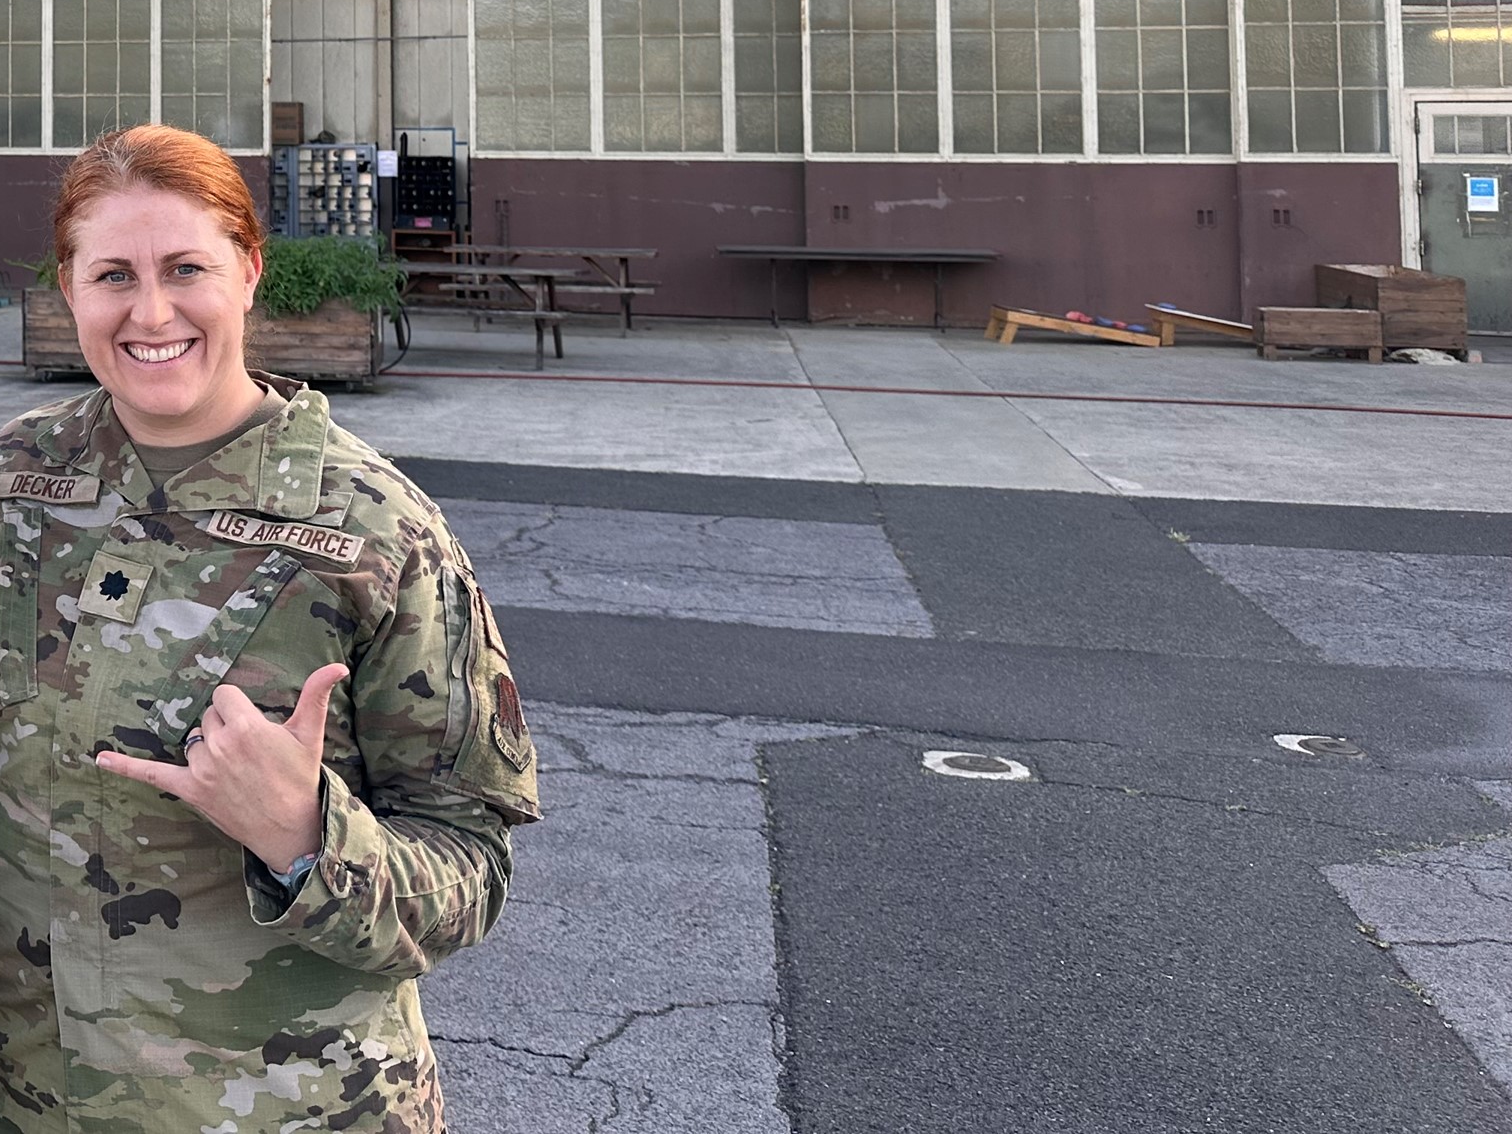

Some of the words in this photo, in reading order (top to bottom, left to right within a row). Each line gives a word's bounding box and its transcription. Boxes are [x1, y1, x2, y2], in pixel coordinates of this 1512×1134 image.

[9, 474, 76, 499] DECKER
[216, 512, 248, 538] U.S.
[250, 522, 285, 542] AIR
[285, 525, 354, 558] FORCE
